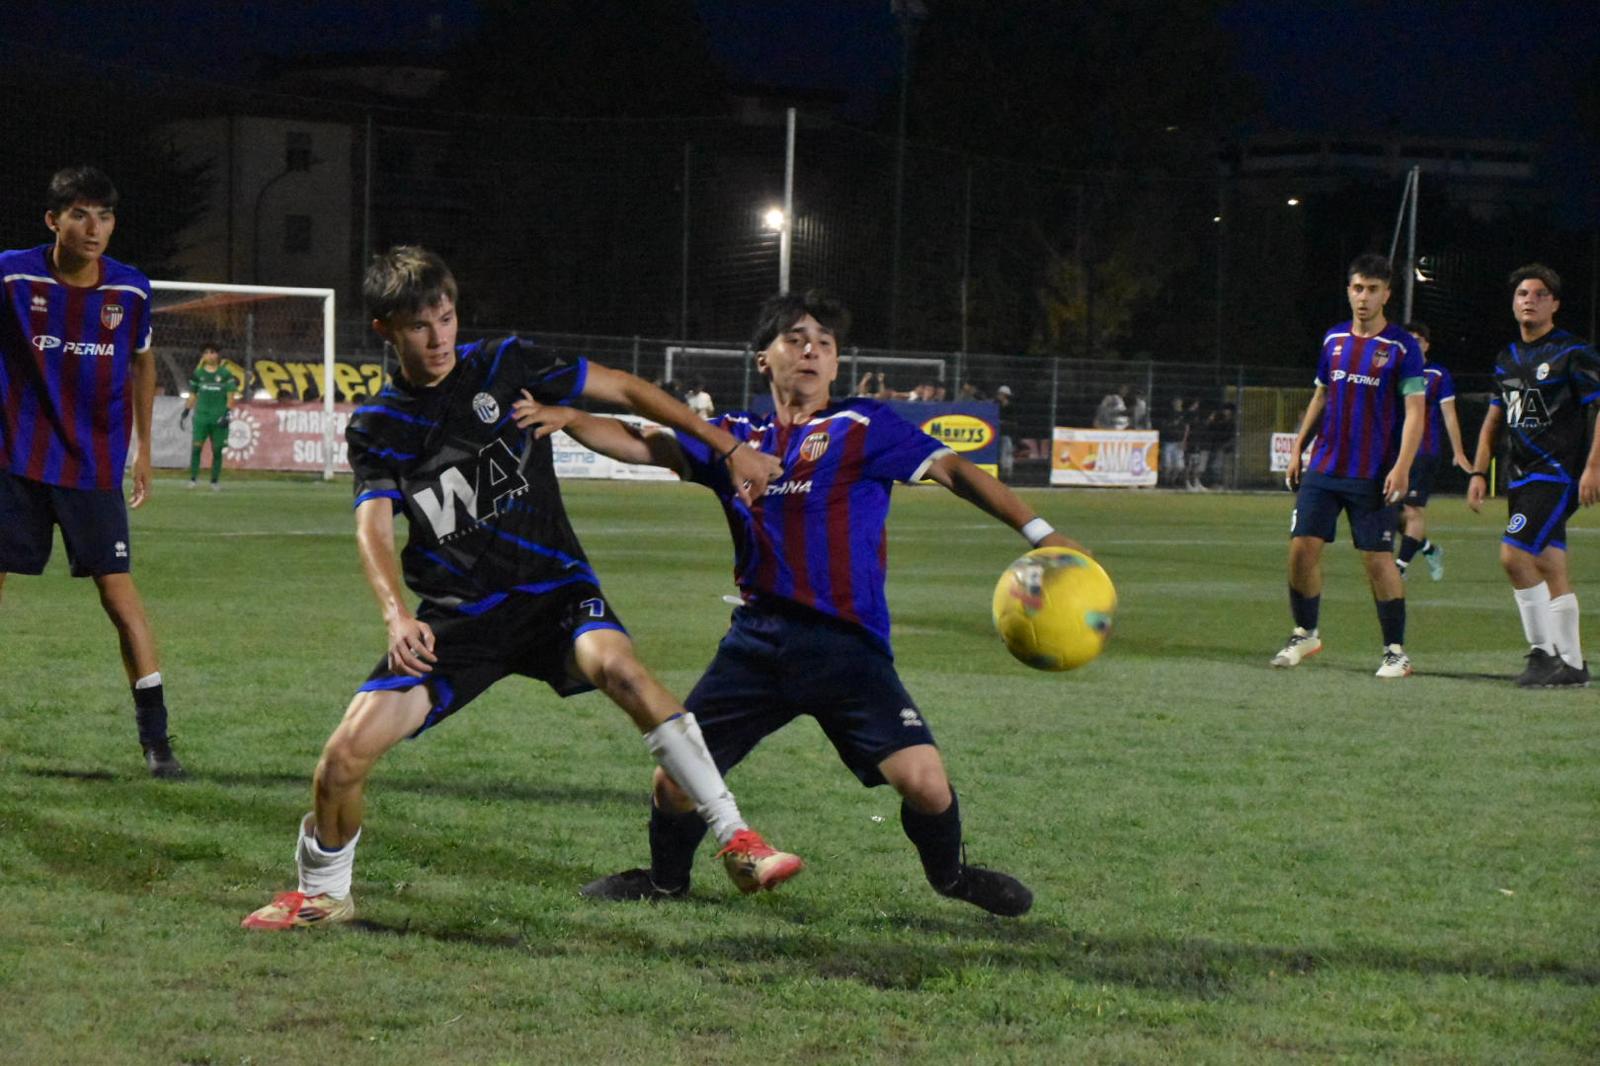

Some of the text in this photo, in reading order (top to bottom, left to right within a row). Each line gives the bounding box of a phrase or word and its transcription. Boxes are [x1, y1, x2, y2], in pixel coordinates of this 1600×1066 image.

[63, 341, 115, 356] PERNA
[1347, 373, 1380, 386] PERNA
[412, 437, 530, 540] WA
[1506, 512, 1528, 534] 9
